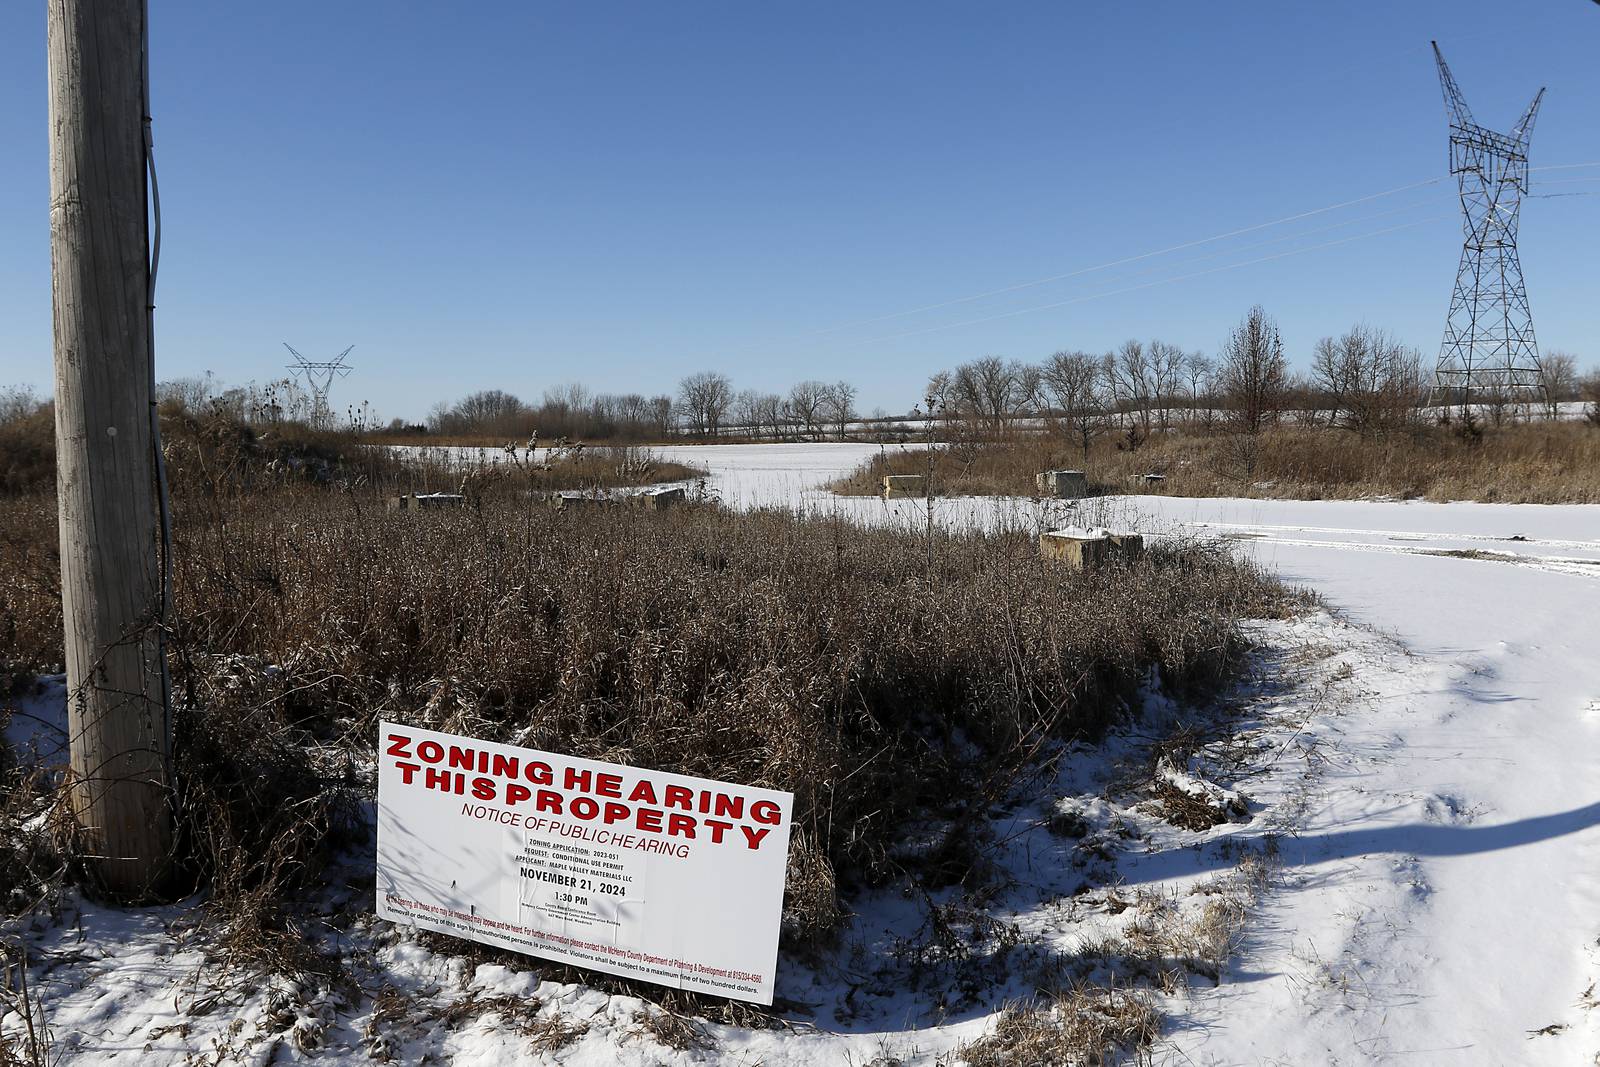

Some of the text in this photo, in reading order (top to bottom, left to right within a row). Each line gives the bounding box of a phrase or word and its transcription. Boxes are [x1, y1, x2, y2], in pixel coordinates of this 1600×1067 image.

[387, 733, 783, 827] ZONING HEARING
[395, 761, 771, 853] THIS PROPERTY
[461, 803, 689, 859] NOTICE OF PUBLIC HEARING
[529, 838, 619, 861] ZONING APPLICATION: 2023-051
[515, 855, 632, 883] APPLICANT: MAPLE VALLEY MATERIALS LLC
[520, 867, 626, 897] NOVEMBER 21, 2024
[552, 852, 590, 865] CONDITIONAL
[591, 859, 601, 867] USE
[603, 862, 624, 871] PERMIT
[555, 892, 588, 905] 1:30 PM
[388, 906, 409, 916] Removal
[417, 913, 438, 924] defacing
[457, 923, 468, 931] sign
[476, 928, 510, 940] unauthorized
[511, 937, 532, 947] persons
[540, 943, 568, 955] prohibited.
[569, 950, 593, 960] Violators
[595, 955, 608, 964] shall
[617, 961, 638, 971] subject
[651, 968, 678, 979] maximum
[680, 973, 690, 981] fine
[699, 977, 710, 985] two
[711, 979, 736, 990] hundred
[737, 983, 759, 994] dollars.
[420, 903, 430, 912] those
[440, 908, 448, 917] may
[448, 909, 453, 917] be
[473, 916, 482, 926] may
[483, 918, 496, 929] appear
[505, 923, 510, 931] be
[531, 929, 545, 939] further
[546, 932, 570, 945] information
[570, 938, 583, 949] please
[584, 941, 599, 952] contact
[608, 946, 626, 959] McHenry
[627, 950, 643, 962] County
[643, 953, 667, 967] Department
[669, 958, 673, 966] of
[674, 959, 693, 973] Planning
[694, 963, 697, 972] &
[698, 964, 727, 979] Development
[728, 969, 732, 979] at
